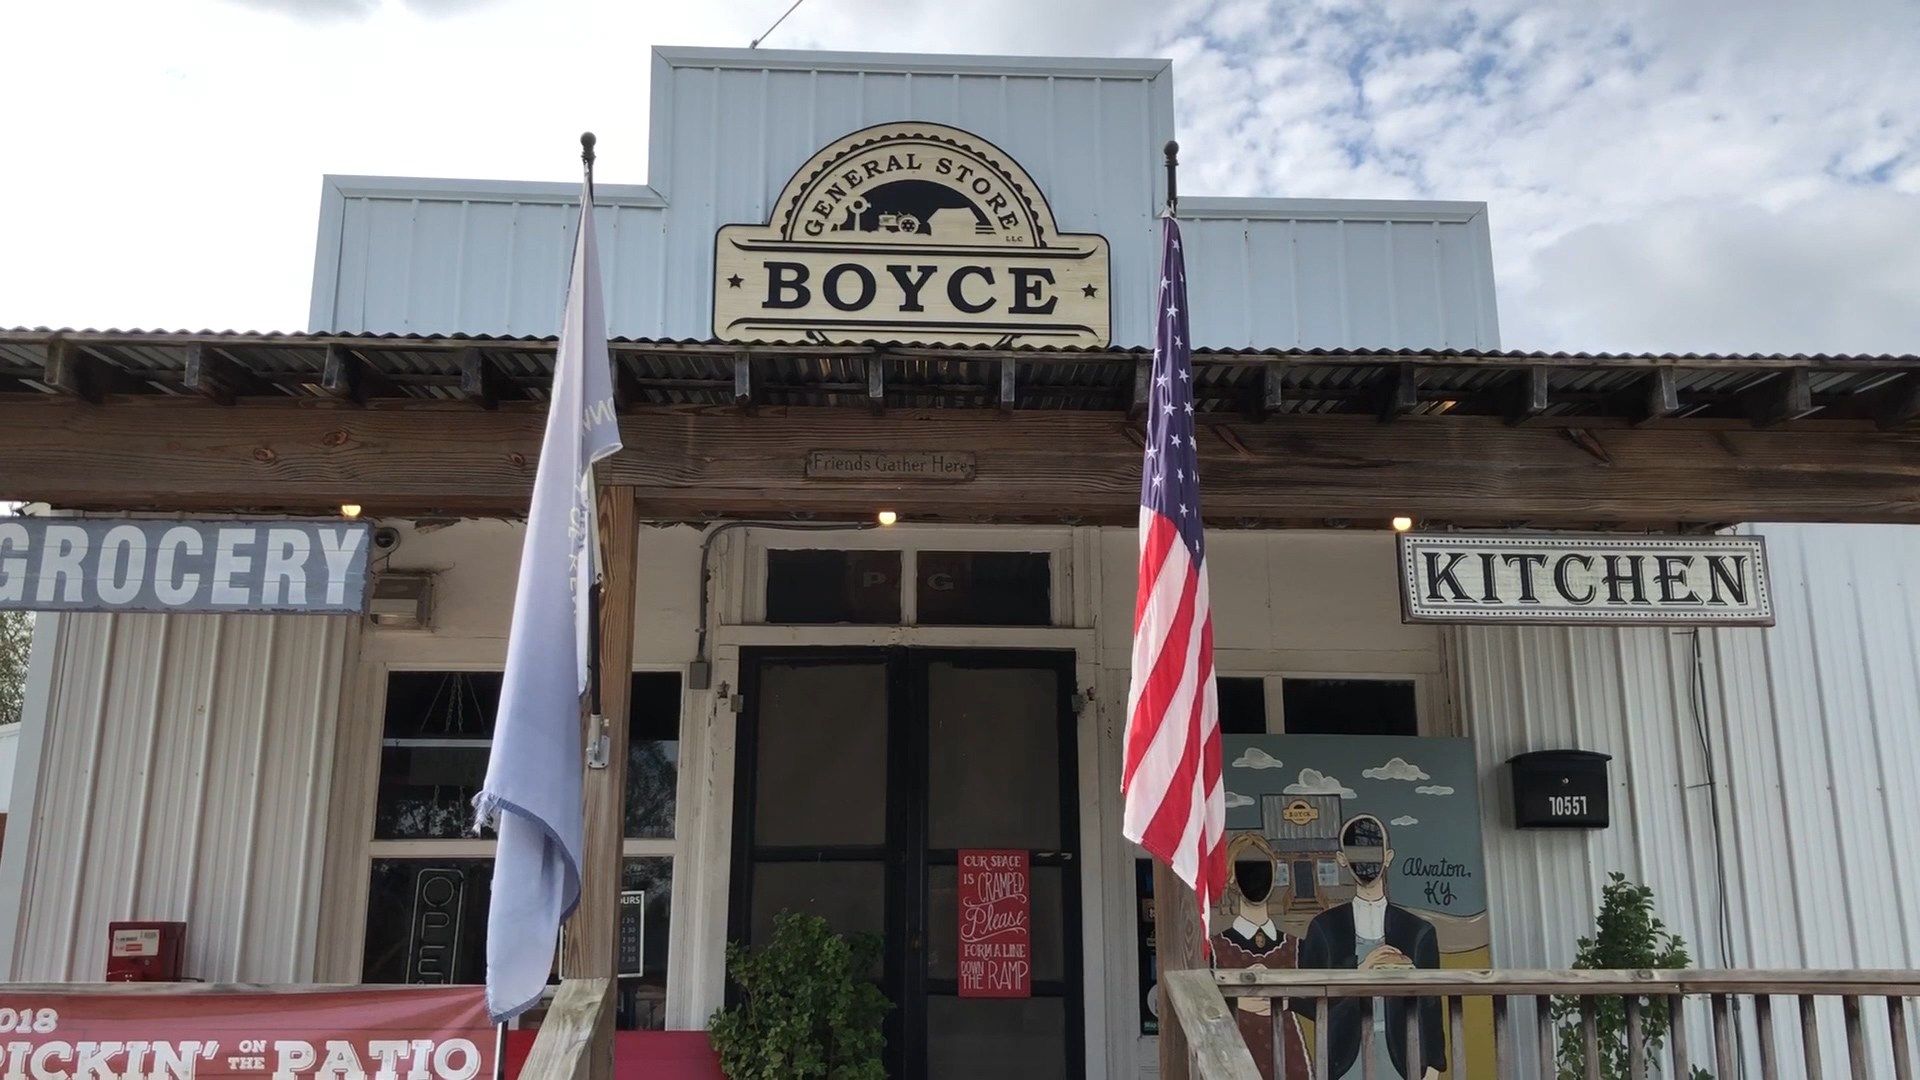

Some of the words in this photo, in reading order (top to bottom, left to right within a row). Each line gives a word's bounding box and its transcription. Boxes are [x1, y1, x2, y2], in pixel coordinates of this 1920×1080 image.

[804, 153, 922, 237] GENERAL
[935, 157, 1019, 231] STORE
[1005, 235, 1023, 243] LLC
[761, 260, 1058, 315] BOYCE
[813, 453, 871, 471] Friends
[875, 455, 927, 473] Gather
[932, 456, 967, 473] Here
[0, 522, 365, 606] GROCERY
[1421, 551, 1749, 607] KITCHEN
[1549, 796, 1588, 816] 10551
[963, 855, 990, 871] OUR
[990, 855, 1022, 871] SPACE
[620, 896, 640, 905] URS
[963, 873, 975, 885] IS
[977, 871, 1025, 903] CRAMPED
[417, 876, 455, 984] OPE
[961, 903, 1028, 938] Please
[964, 944, 992, 961] FORM
[993, 944, 1001, 957] A
[1002, 944, 1026, 958] LINE
[961, 960, 985, 975] DOWN
[962, 974, 984, 990] THE
[987, 960, 1029, 991] RAMP
[0, 1007, 59, 1034] 018
[0, 1040, 220, 1080] ICKIN'
[238, 1039, 267, 1053] ON
[271, 1037, 482, 1080] PATIO
[228, 1056, 265, 1070] THE
